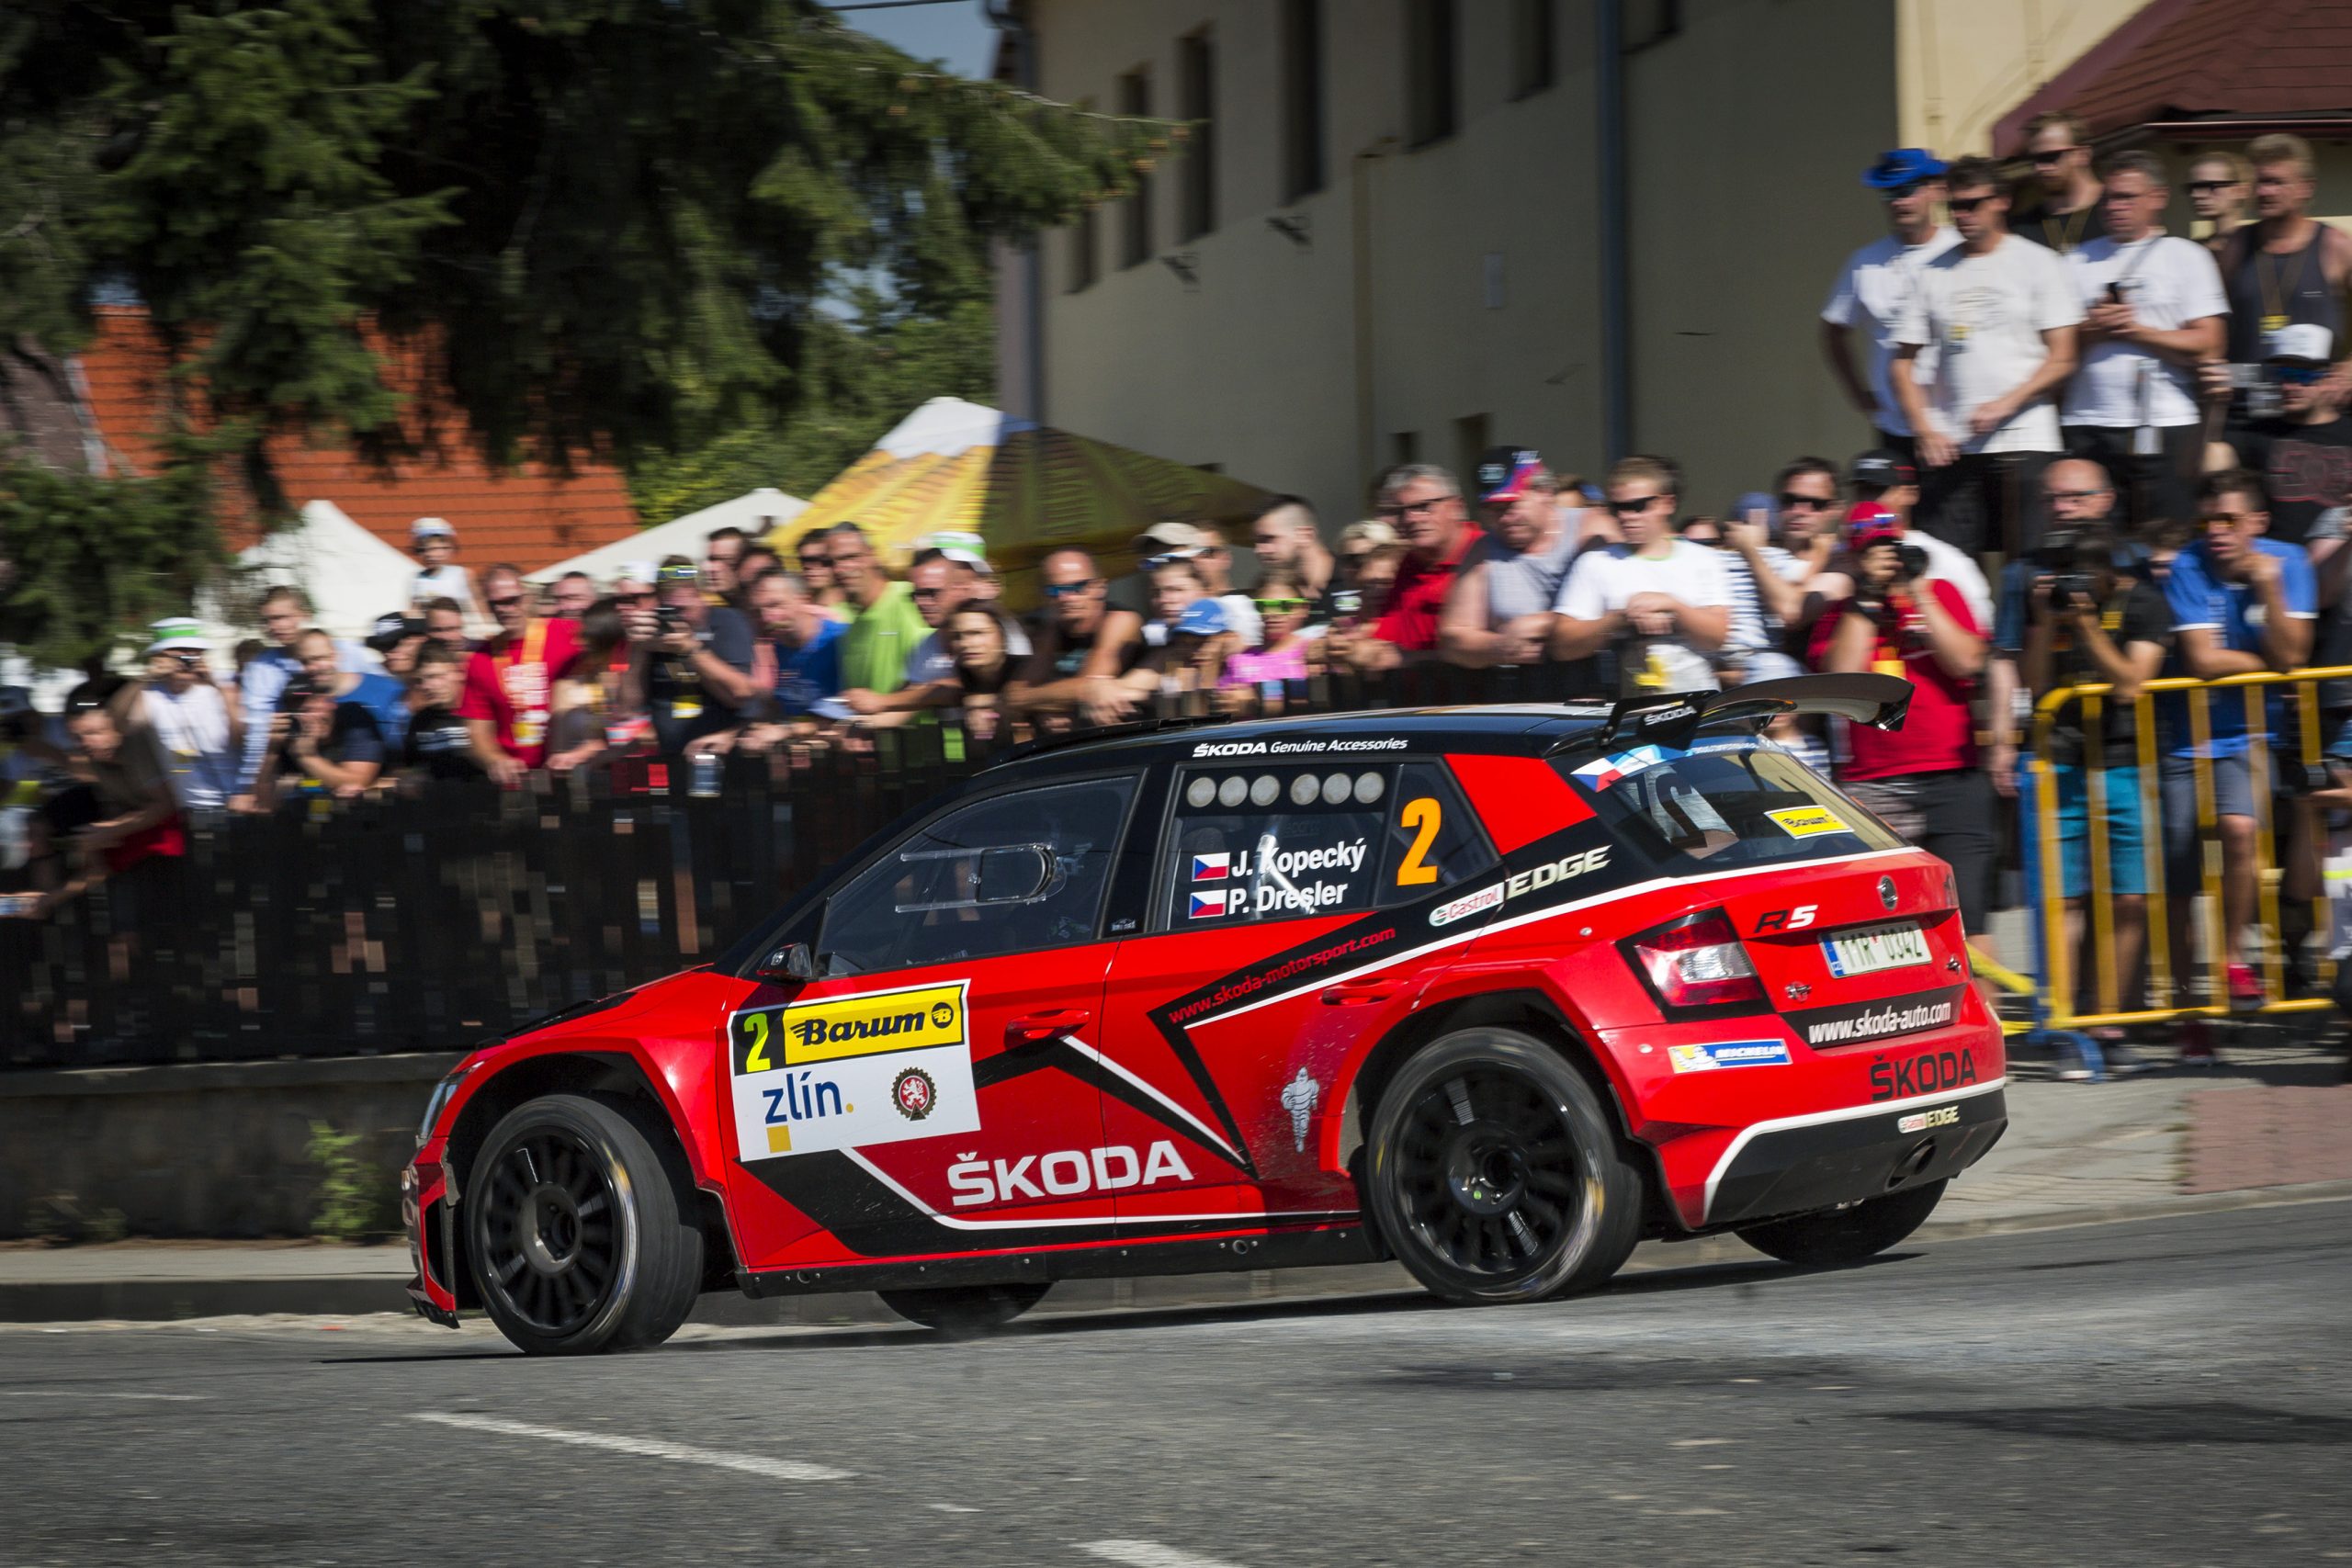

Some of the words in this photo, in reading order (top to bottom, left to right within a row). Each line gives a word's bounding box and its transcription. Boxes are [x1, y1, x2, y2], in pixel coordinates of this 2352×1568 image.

[1643, 705, 1698, 726] ŠKODA
[1192, 742, 1268, 758] ŠKODA
[1270, 739, 1326, 753] Genuine
[1327, 738, 1409, 751] Accessories
[1231, 851, 1253, 877] J.
[1260, 837, 1367, 879] Kopecký
[1396, 796, 1442, 886] 2
[1227, 887, 1250, 915] P.
[1256, 880, 1349, 913] Dresler
[1448, 888, 1500, 919] Castrol
[1505, 844, 1613, 899] EDGE
[1754, 904, 1819, 934] R5
[1167, 927, 1396, 1024] www.skoda-motorsport.com
[743, 1012, 772, 1074] 2
[790, 1011, 925, 1046] Barum
[1808, 1001, 1951, 1044] www.skoda-auto.com
[1870, 1048, 1977, 1101] ŠKODA
[947, 1139, 1194, 1206] ŠKODA
